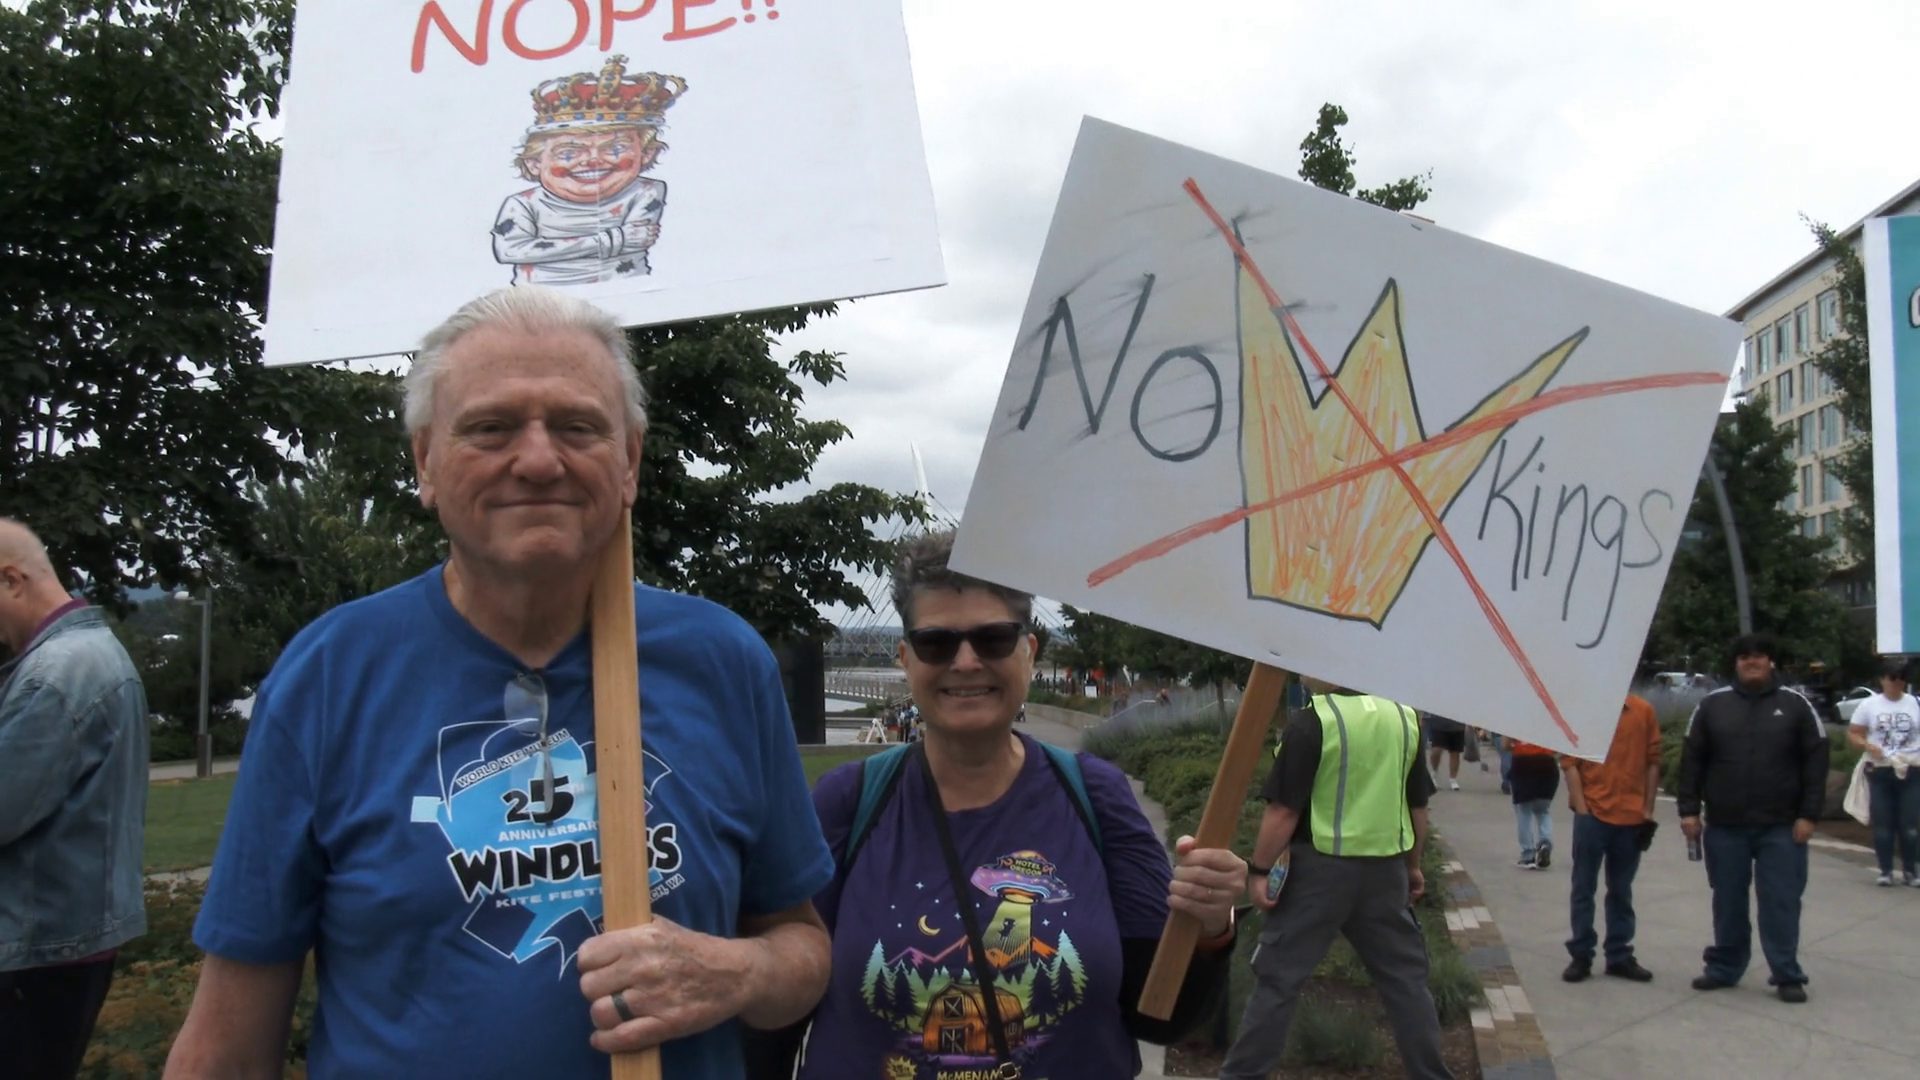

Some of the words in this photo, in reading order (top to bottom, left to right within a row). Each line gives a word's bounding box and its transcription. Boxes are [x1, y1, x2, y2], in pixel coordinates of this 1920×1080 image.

[1477, 435, 1673, 650] Kings
[456, 760, 501, 788] WORLD
[499, 748, 525, 769] KITE
[523, 728, 570, 759] MUEUM
[498, 821, 599, 842] ANNIVERSAR
[447, 823, 682, 903] WINDLS
[1010, 864, 1043, 876] OREGON
[1015, 859, 1041, 870] HOTEL
[665, 873, 686, 889] WA
[496, 893, 543, 908] KITE
[549, 887, 602, 902] FEST
